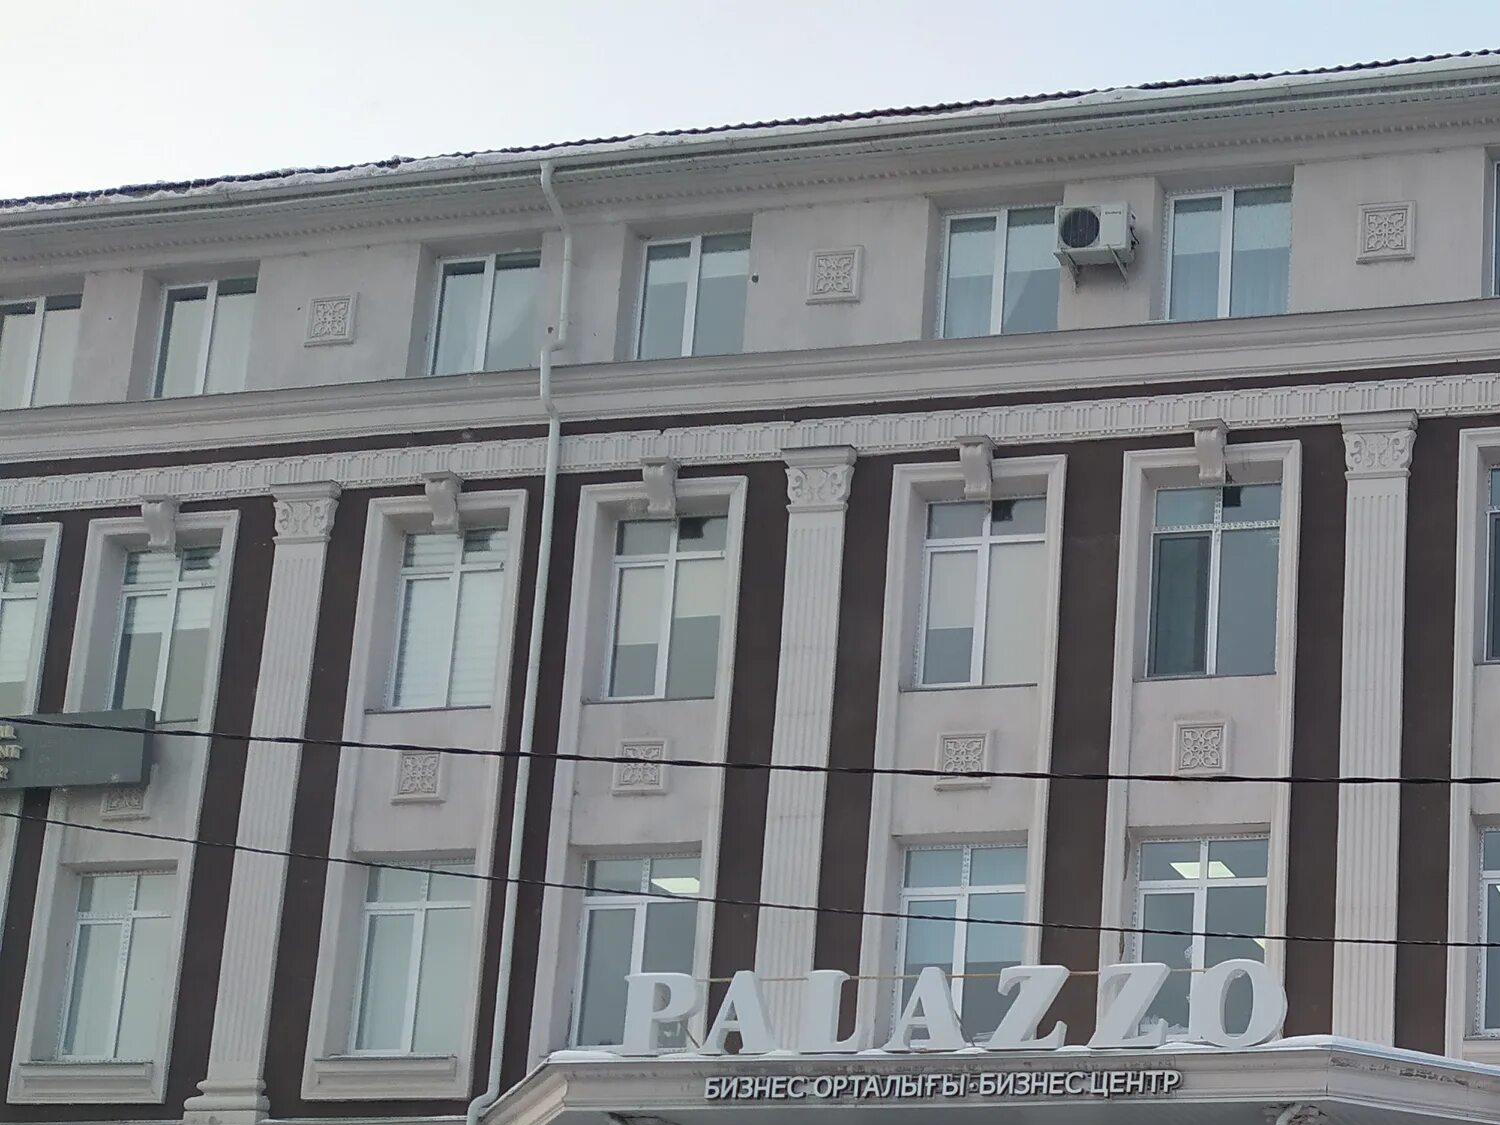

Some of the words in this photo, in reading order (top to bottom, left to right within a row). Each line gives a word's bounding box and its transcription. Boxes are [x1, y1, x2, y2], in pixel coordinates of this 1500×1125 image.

[620, 958, 1288, 1056] PALAZZO
[703, 1075, 807, 1099] БИЗНЕС
[813, 1073, 966, 1098] ОРТАЛЫҒЫ
[979, 1072, 1085, 1096] БИЗНЕС
[1090, 1070, 1182, 1098] ЦЕНТР
